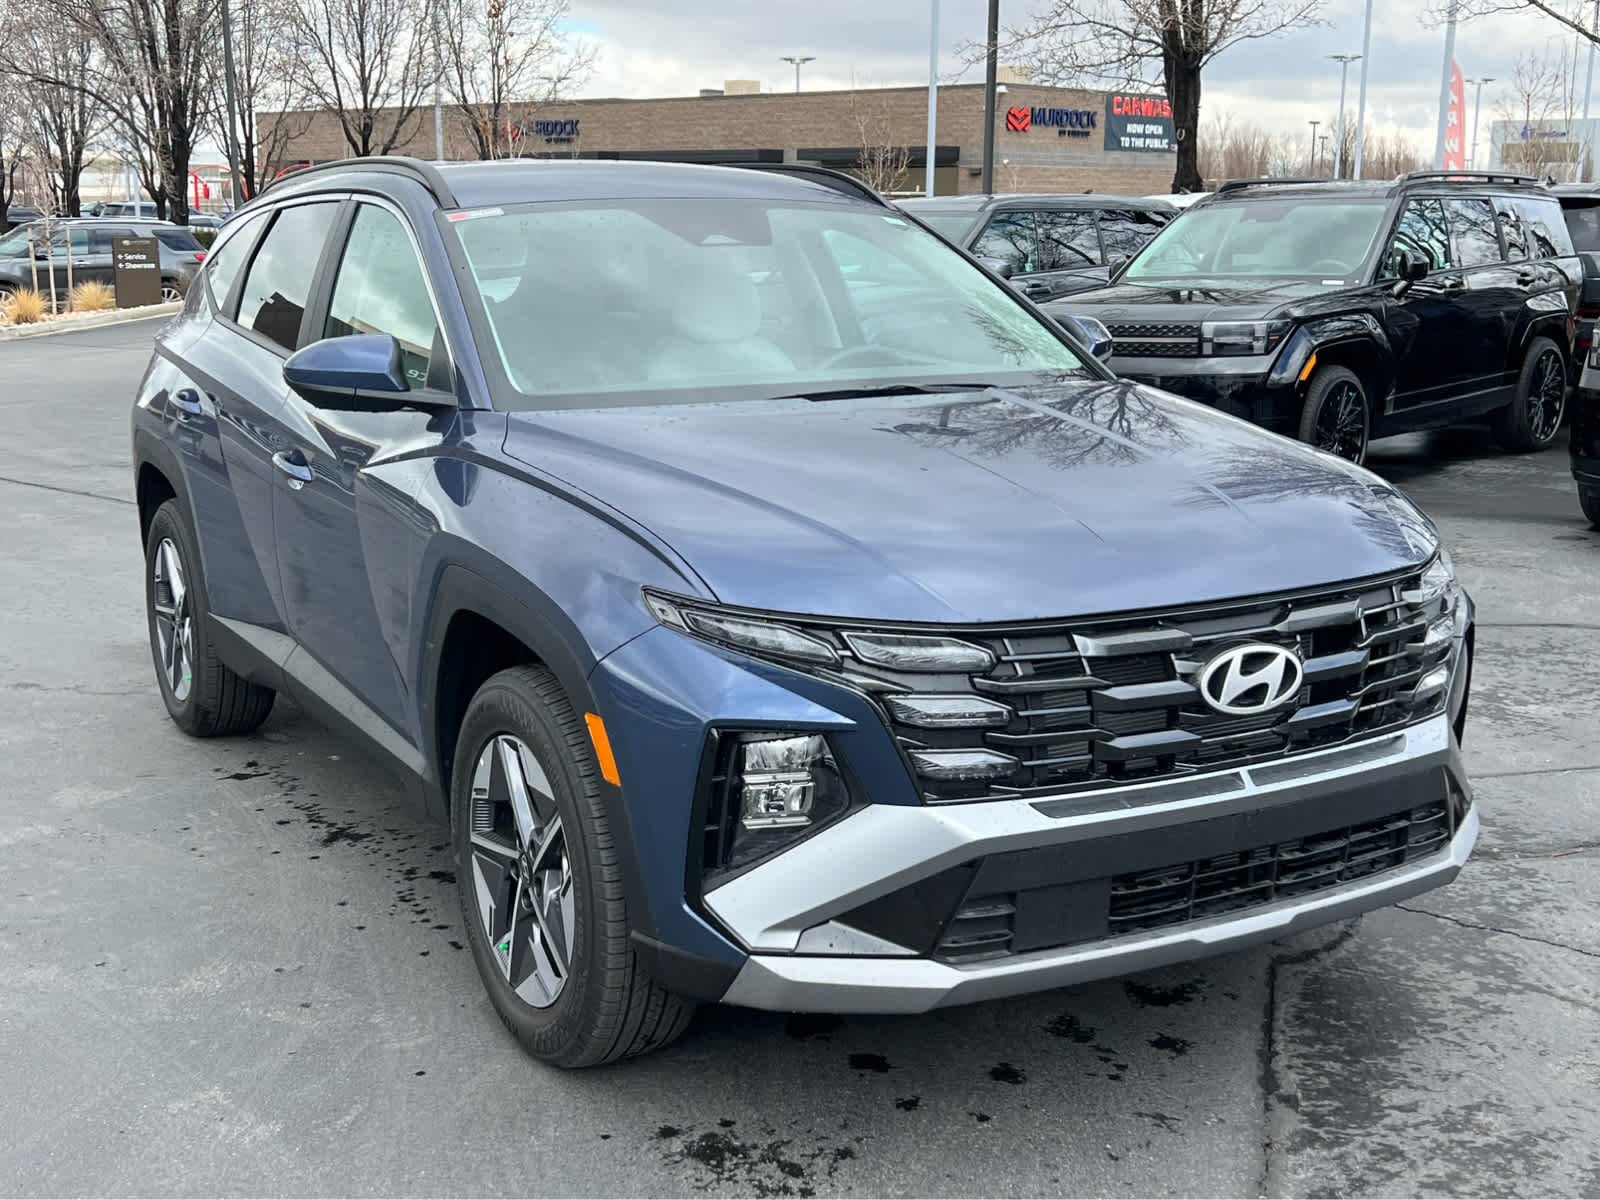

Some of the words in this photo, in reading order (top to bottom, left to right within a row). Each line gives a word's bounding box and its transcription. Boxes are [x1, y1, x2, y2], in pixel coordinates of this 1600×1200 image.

[1112, 96, 1173, 118] CARWAS
[1031, 107, 1098, 128] MURDOCK
[1126, 123, 1144, 134] NOW
[1145, 124, 1163, 135] OPEN
[1120, 137, 1130, 147] TO
[1131, 137, 1145, 149] THE
[1145, 138, 1169, 150] PUBLIC
